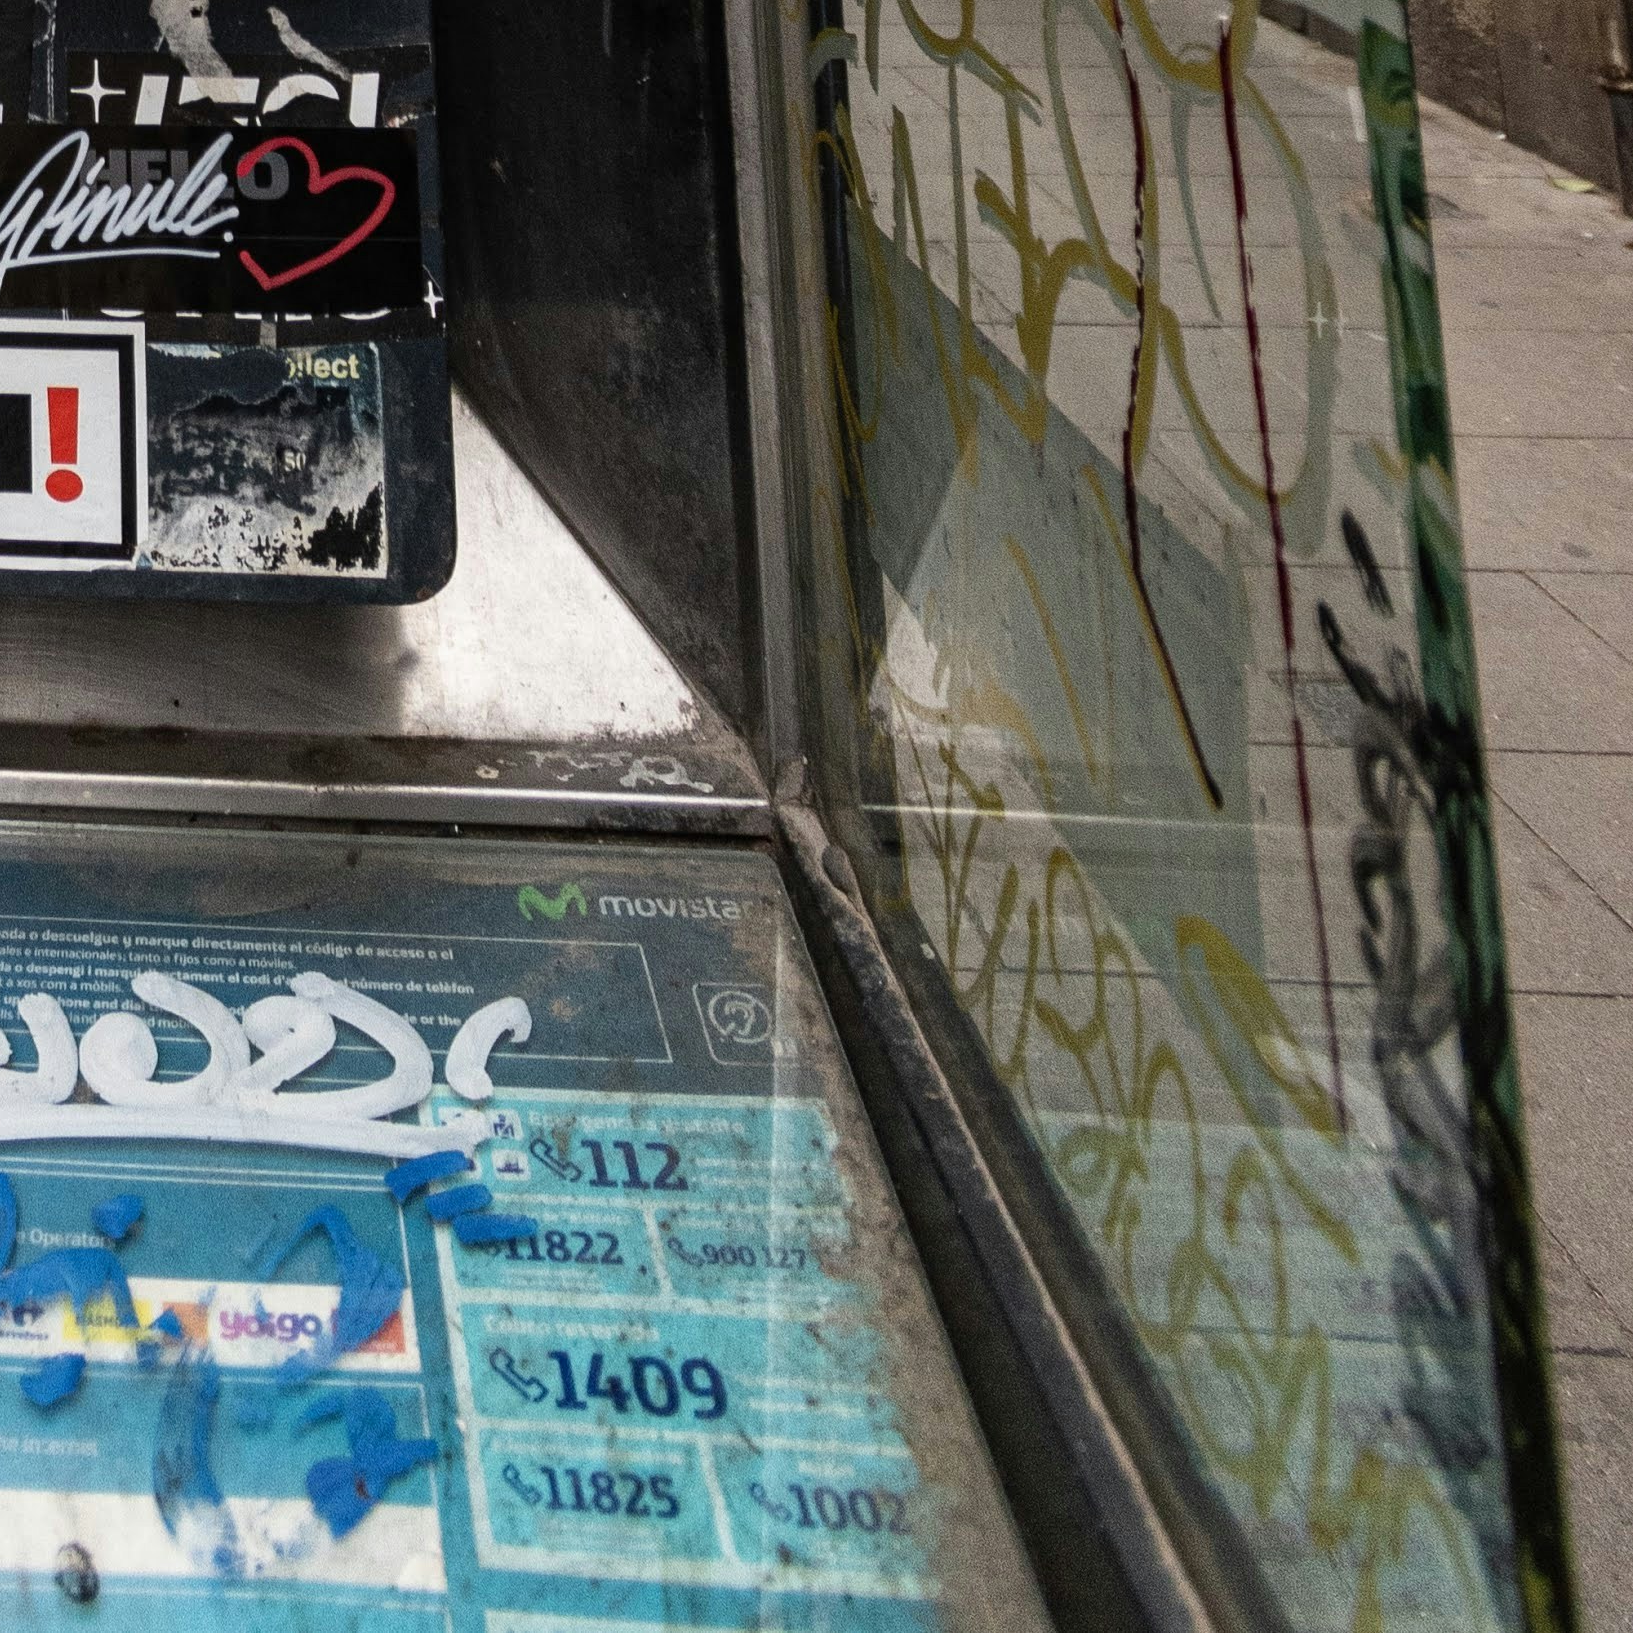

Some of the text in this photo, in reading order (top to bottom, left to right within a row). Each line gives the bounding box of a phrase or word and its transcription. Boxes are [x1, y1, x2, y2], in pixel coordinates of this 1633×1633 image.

[599, 895, 758, 921] movistar
[41, 929, 118, 947] descuelgue
[134, 936, 188, 951] marque
[192, 936, 286, 952] directamente
[304, 941, 350, 958] código
[355, 944, 372, 956] de
[581, 1139, 689, 1191] 112
[29, 1228, 115, 1249] Operator
[504, 1231, 624, 1266] 11822
[700, 1245, 756, 1268] 900
[548, 1350, 729, 1420] 1409
[540, 1465, 681, 1519] 11825
